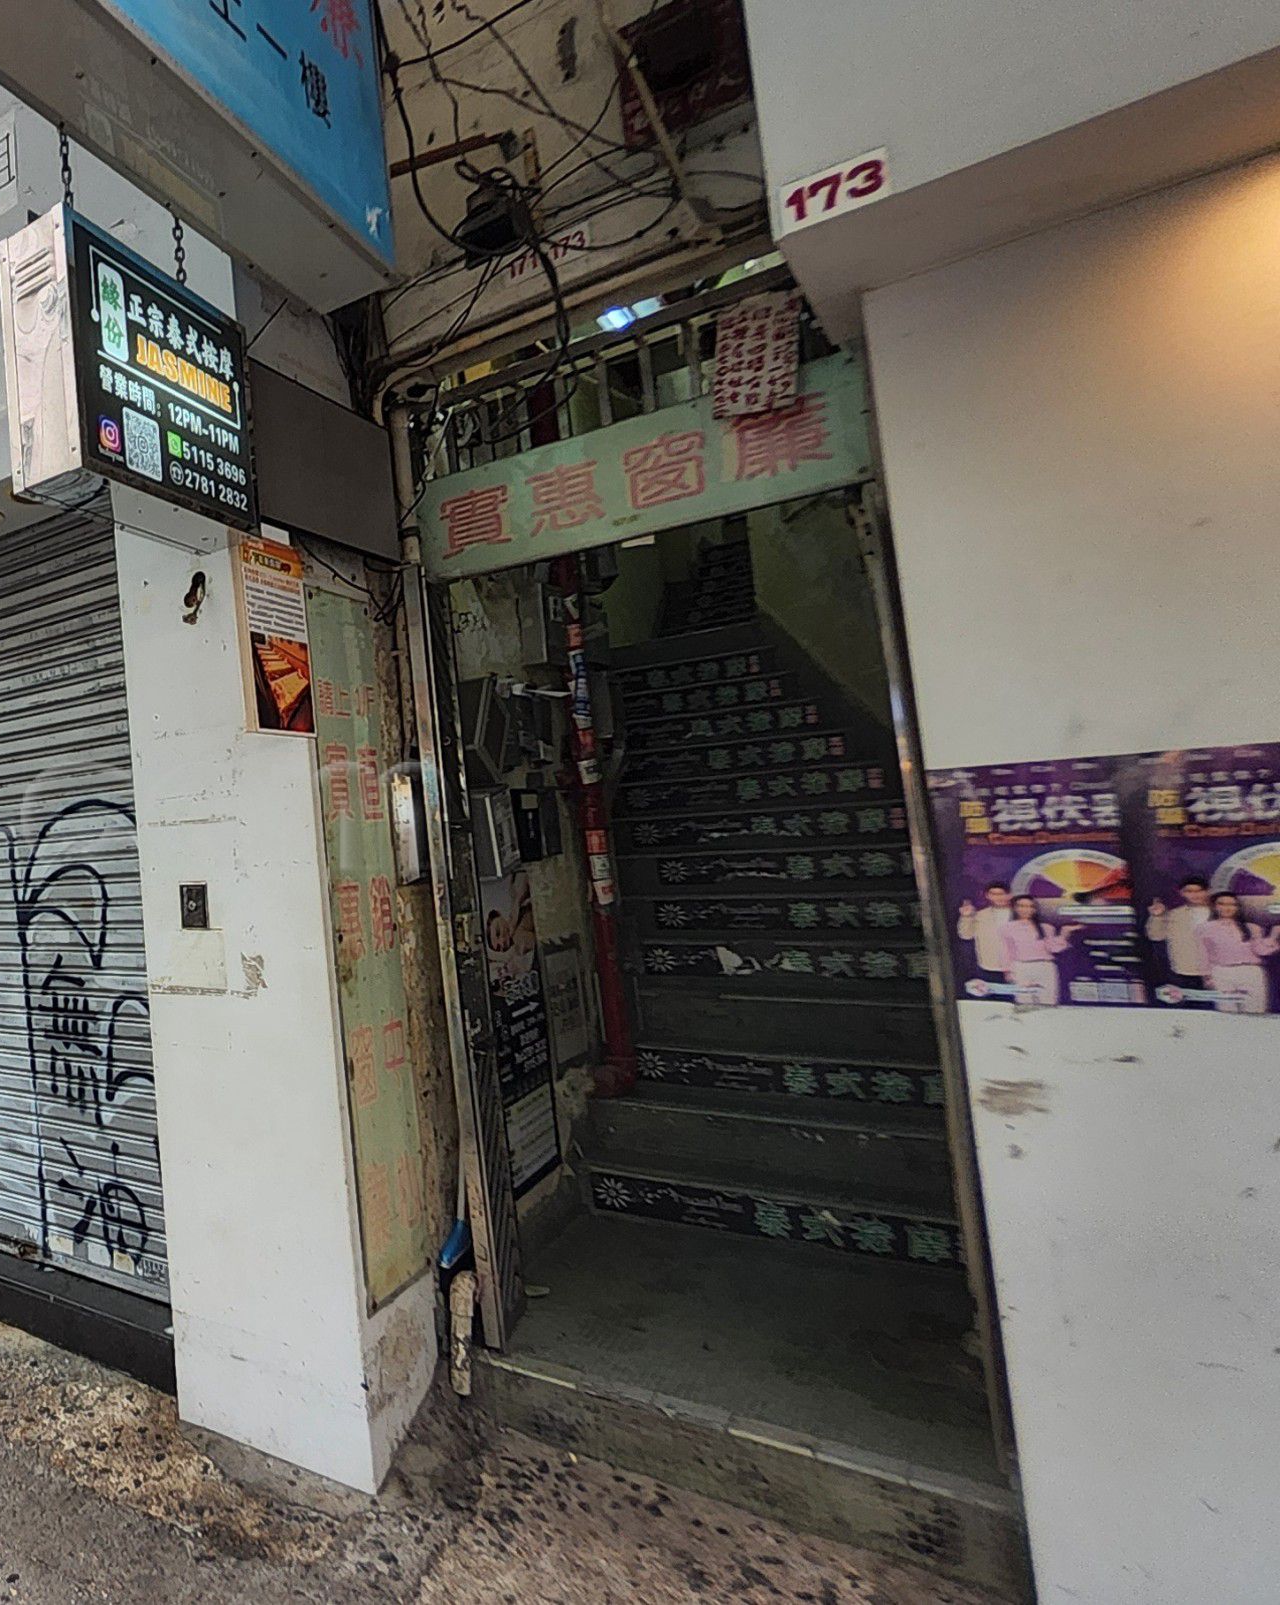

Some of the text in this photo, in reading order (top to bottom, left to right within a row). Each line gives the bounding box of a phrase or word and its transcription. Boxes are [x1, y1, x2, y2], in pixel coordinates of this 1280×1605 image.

[784, 158, 886, 222] 173
[127, 294, 234, 382] 正宗泰式按摩
[136, 334, 233, 414] JASMINE
[167, 402, 240, 455] 12PM-11PM
[182, 441, 247, 487] 5115 3696
[184, 469, 248, 511] 2781 2832
[437, 403, 833, 560] 實惠窗簾
